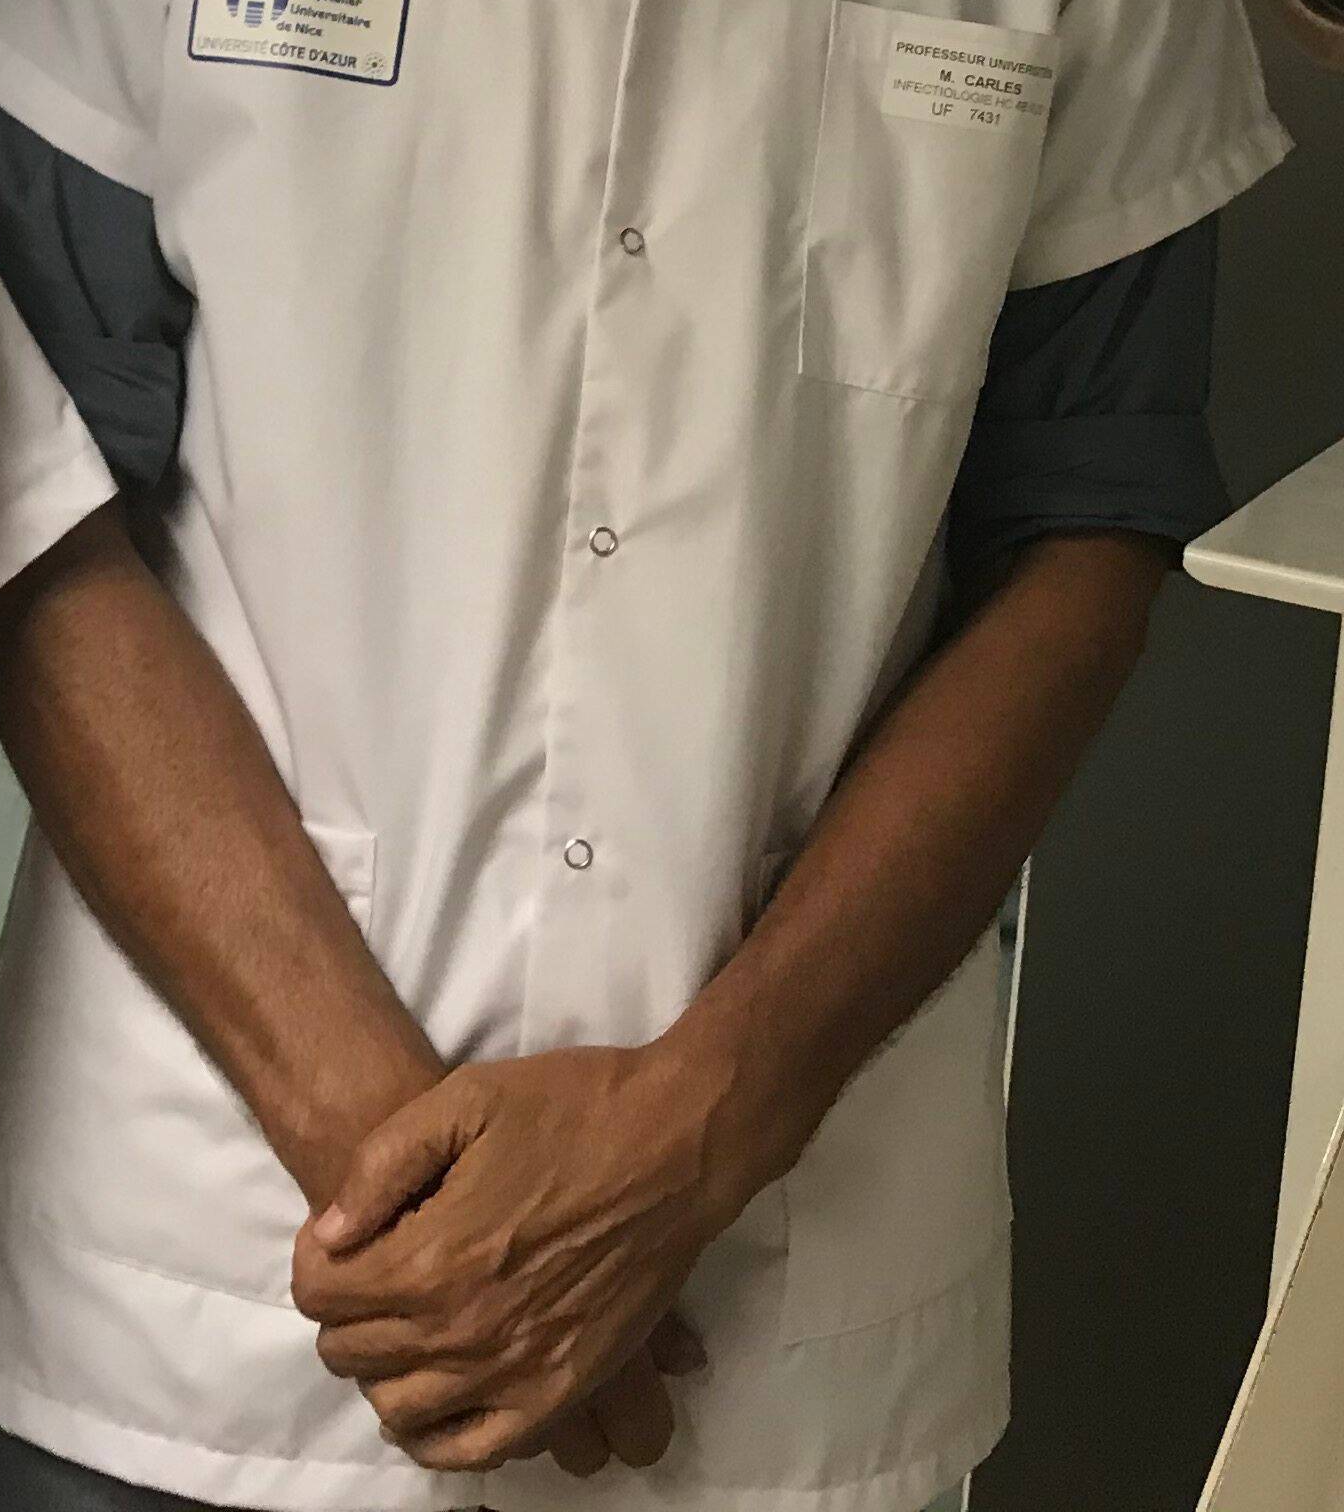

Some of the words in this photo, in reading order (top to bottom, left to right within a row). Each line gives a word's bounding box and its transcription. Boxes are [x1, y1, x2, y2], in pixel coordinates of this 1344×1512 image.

[276, 20, 292, 34] de
[295, 22, 323, 38] Nice
[290, 2, 371, 30] Universitaire
[270, 41, 305, 61] CÔTE
[309, 46, 358, 70] D'AZUR
[896, 40, 986, 68] PROFESSEUR
[893, 78, 993, 106] INFECTIOLOGIE
[940, 69, 955, 84] M.
[965, 74, 1024, 96] CARLES
[931, 101, 954, 117] UF
[970, 108, 1001, 127] 7431
